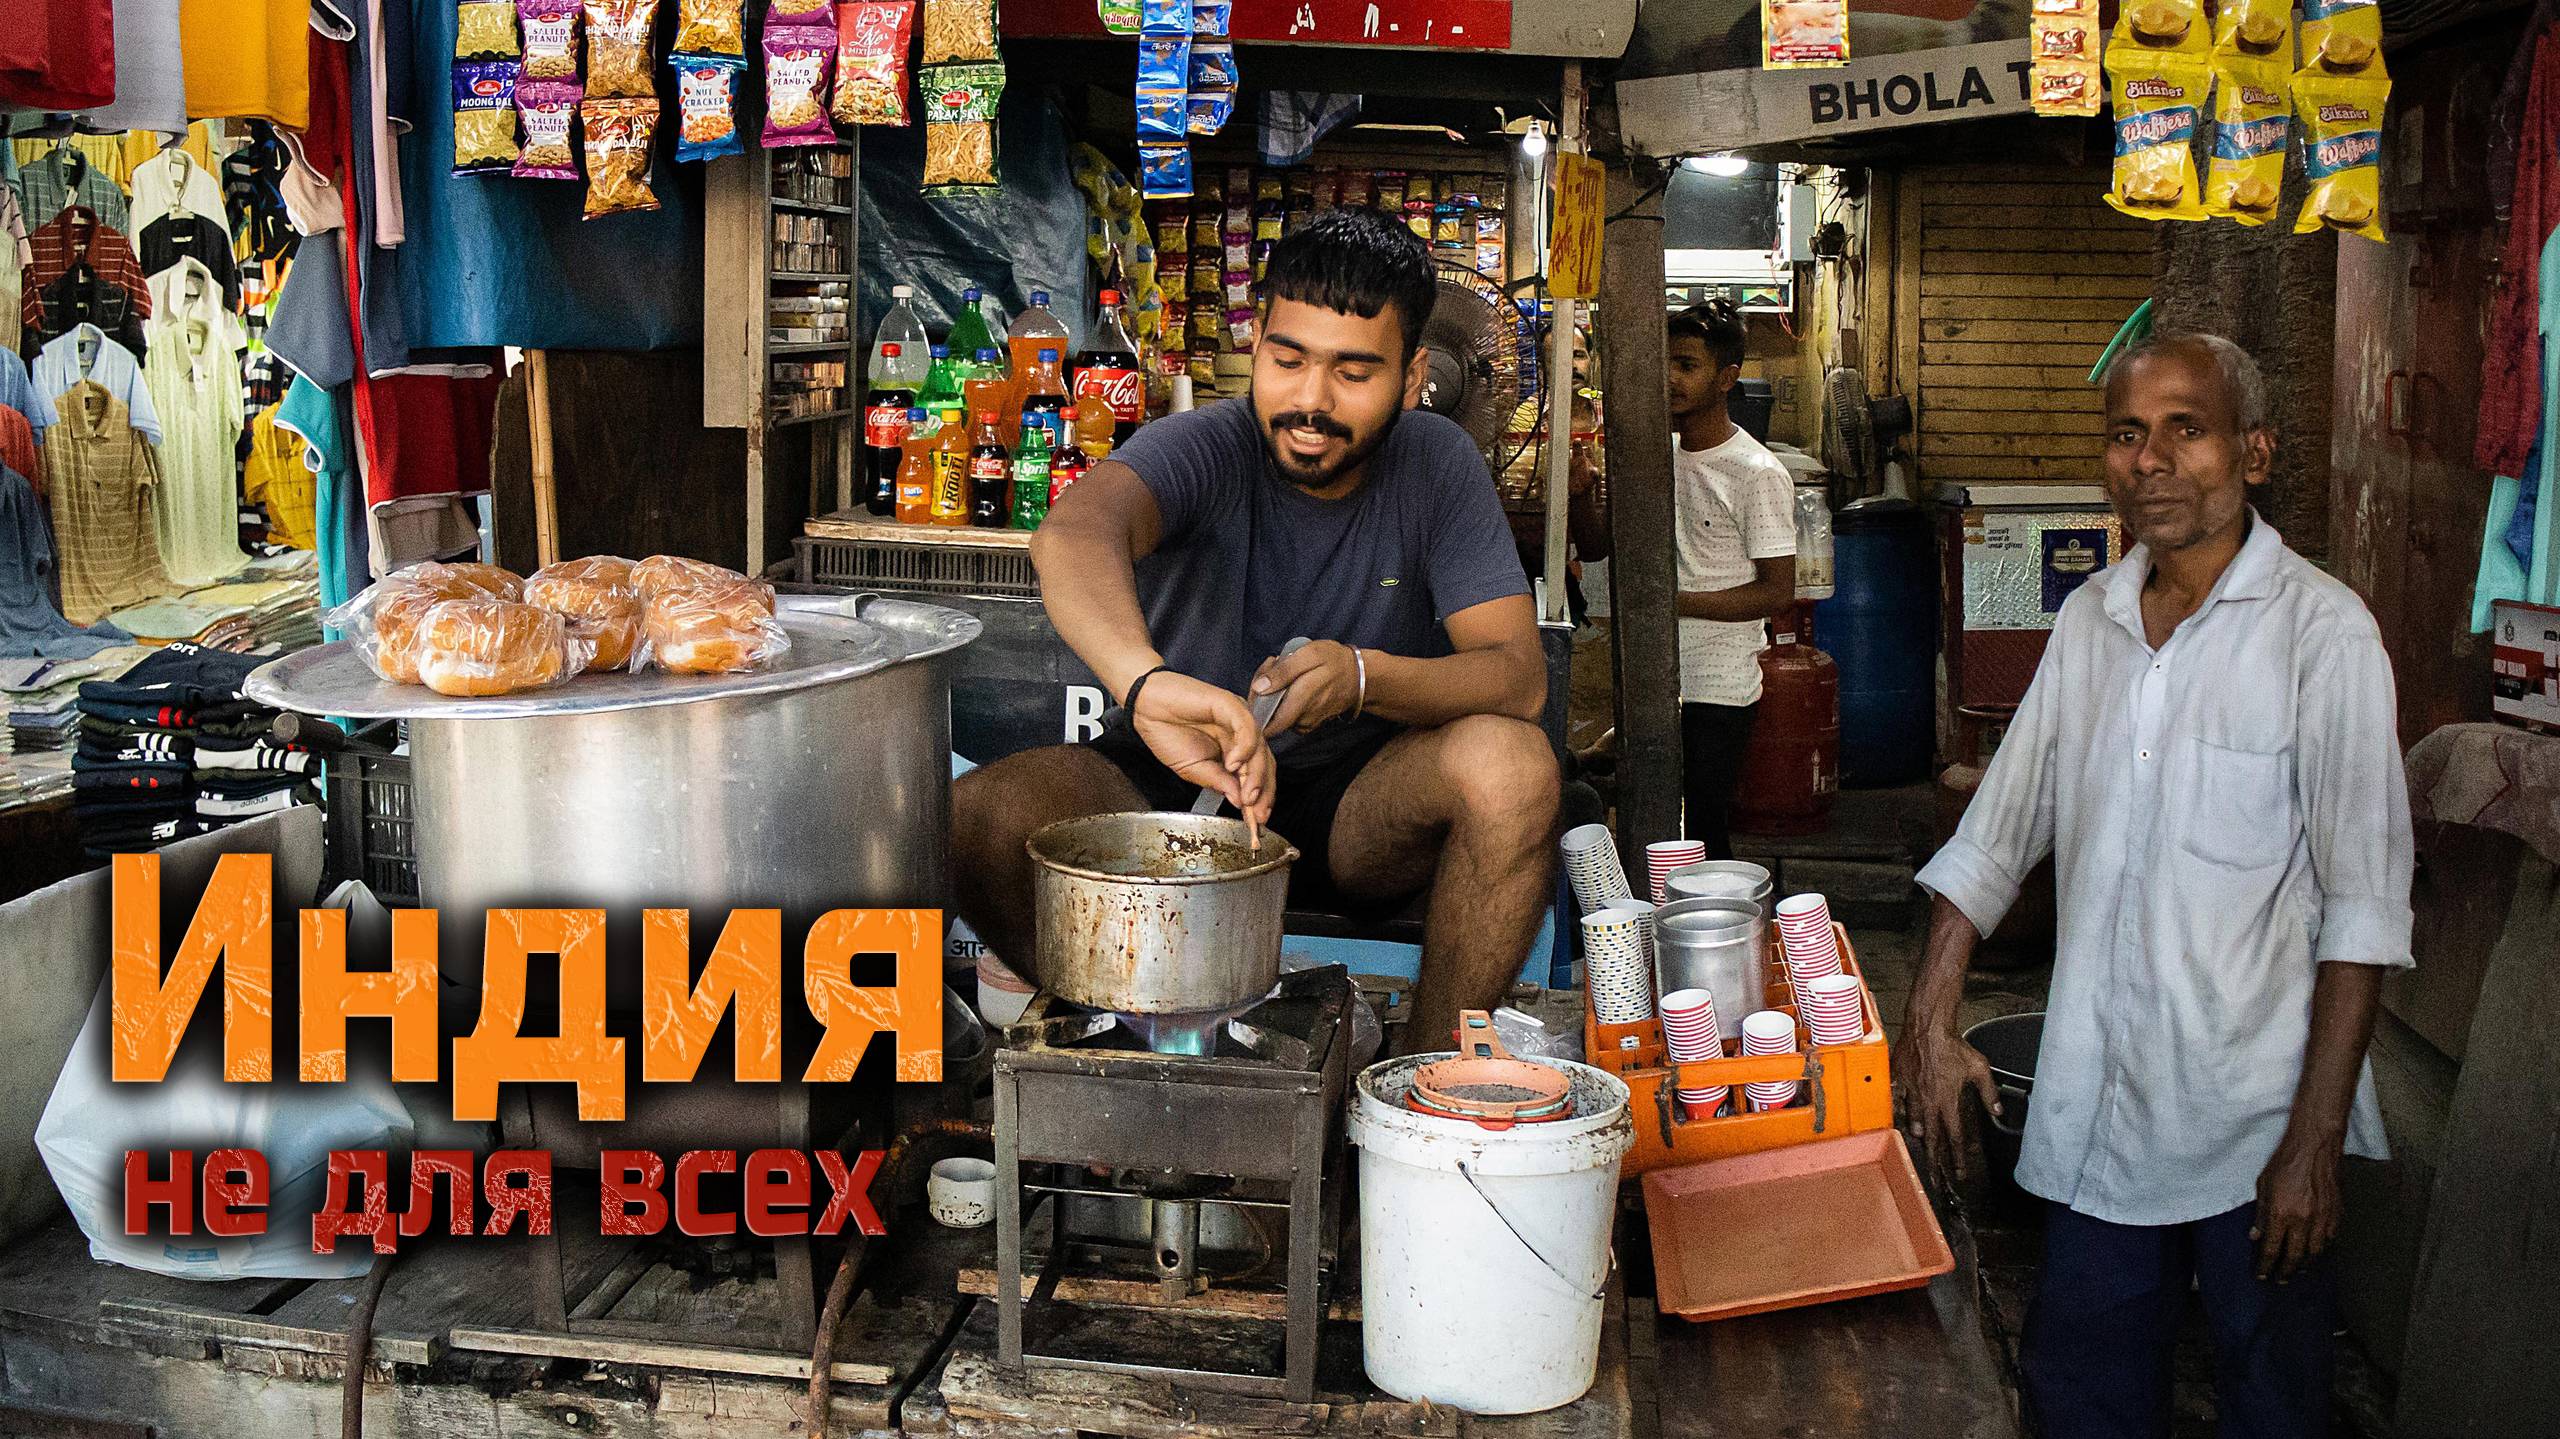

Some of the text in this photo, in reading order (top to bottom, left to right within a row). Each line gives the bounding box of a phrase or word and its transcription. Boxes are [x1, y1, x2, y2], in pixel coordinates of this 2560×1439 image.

[533, 27, 566, 35] SALTED
[528, 35, 569, 43] PEANUTS
[695, 87, 713, 96] NUT
[2126, 80, 2184, 98] Bikaner
[1809, 66, 1995, 124] BHOLA
[460, 97, 513, 108] MOONG DAL
[685, 98, 725, 107] CRACKER
[2319, 105, 2369, 122] Bikaner
[532, 117, 564, 125] SALTED
